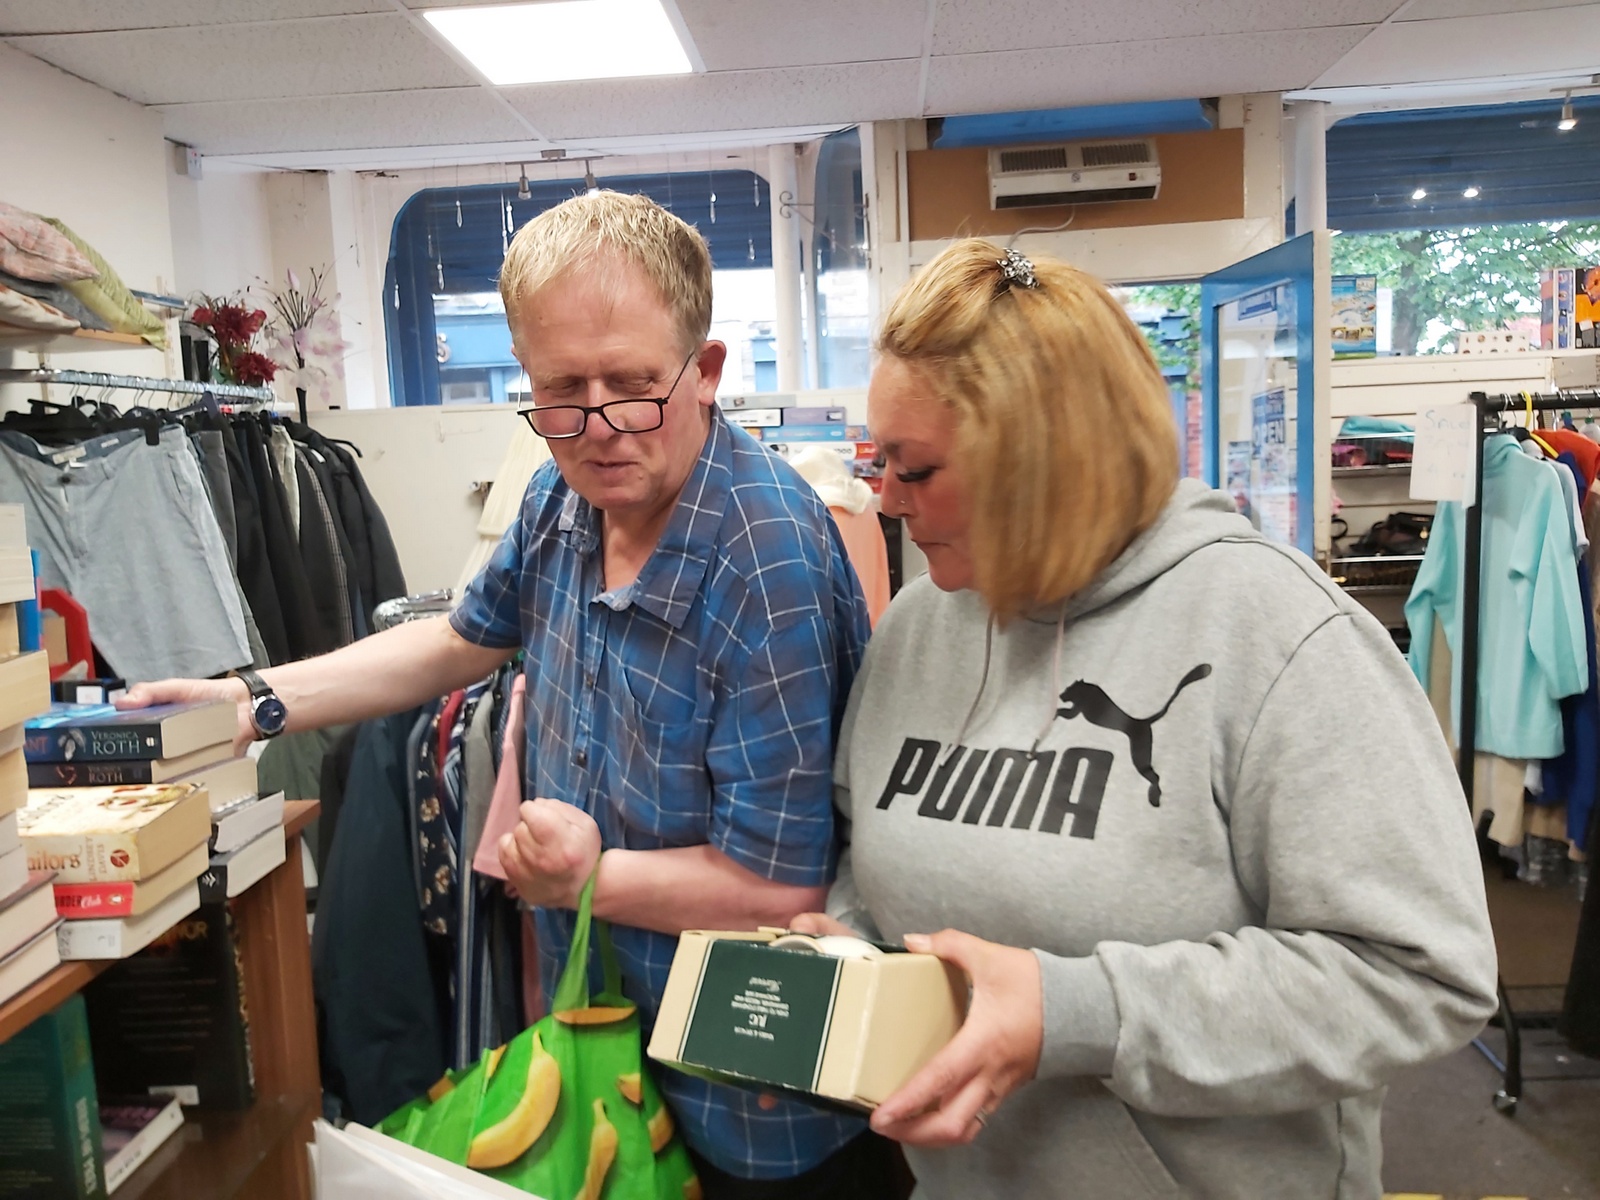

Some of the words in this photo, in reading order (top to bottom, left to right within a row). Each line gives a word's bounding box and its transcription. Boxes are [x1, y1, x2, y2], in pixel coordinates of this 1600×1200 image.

[91, 731, 139, 740] VERONICA
[93, 739, 140, 755] ROTH
[89, 771, 123, 783] ROTH
[876, 737, 1114, 840] PUMA
